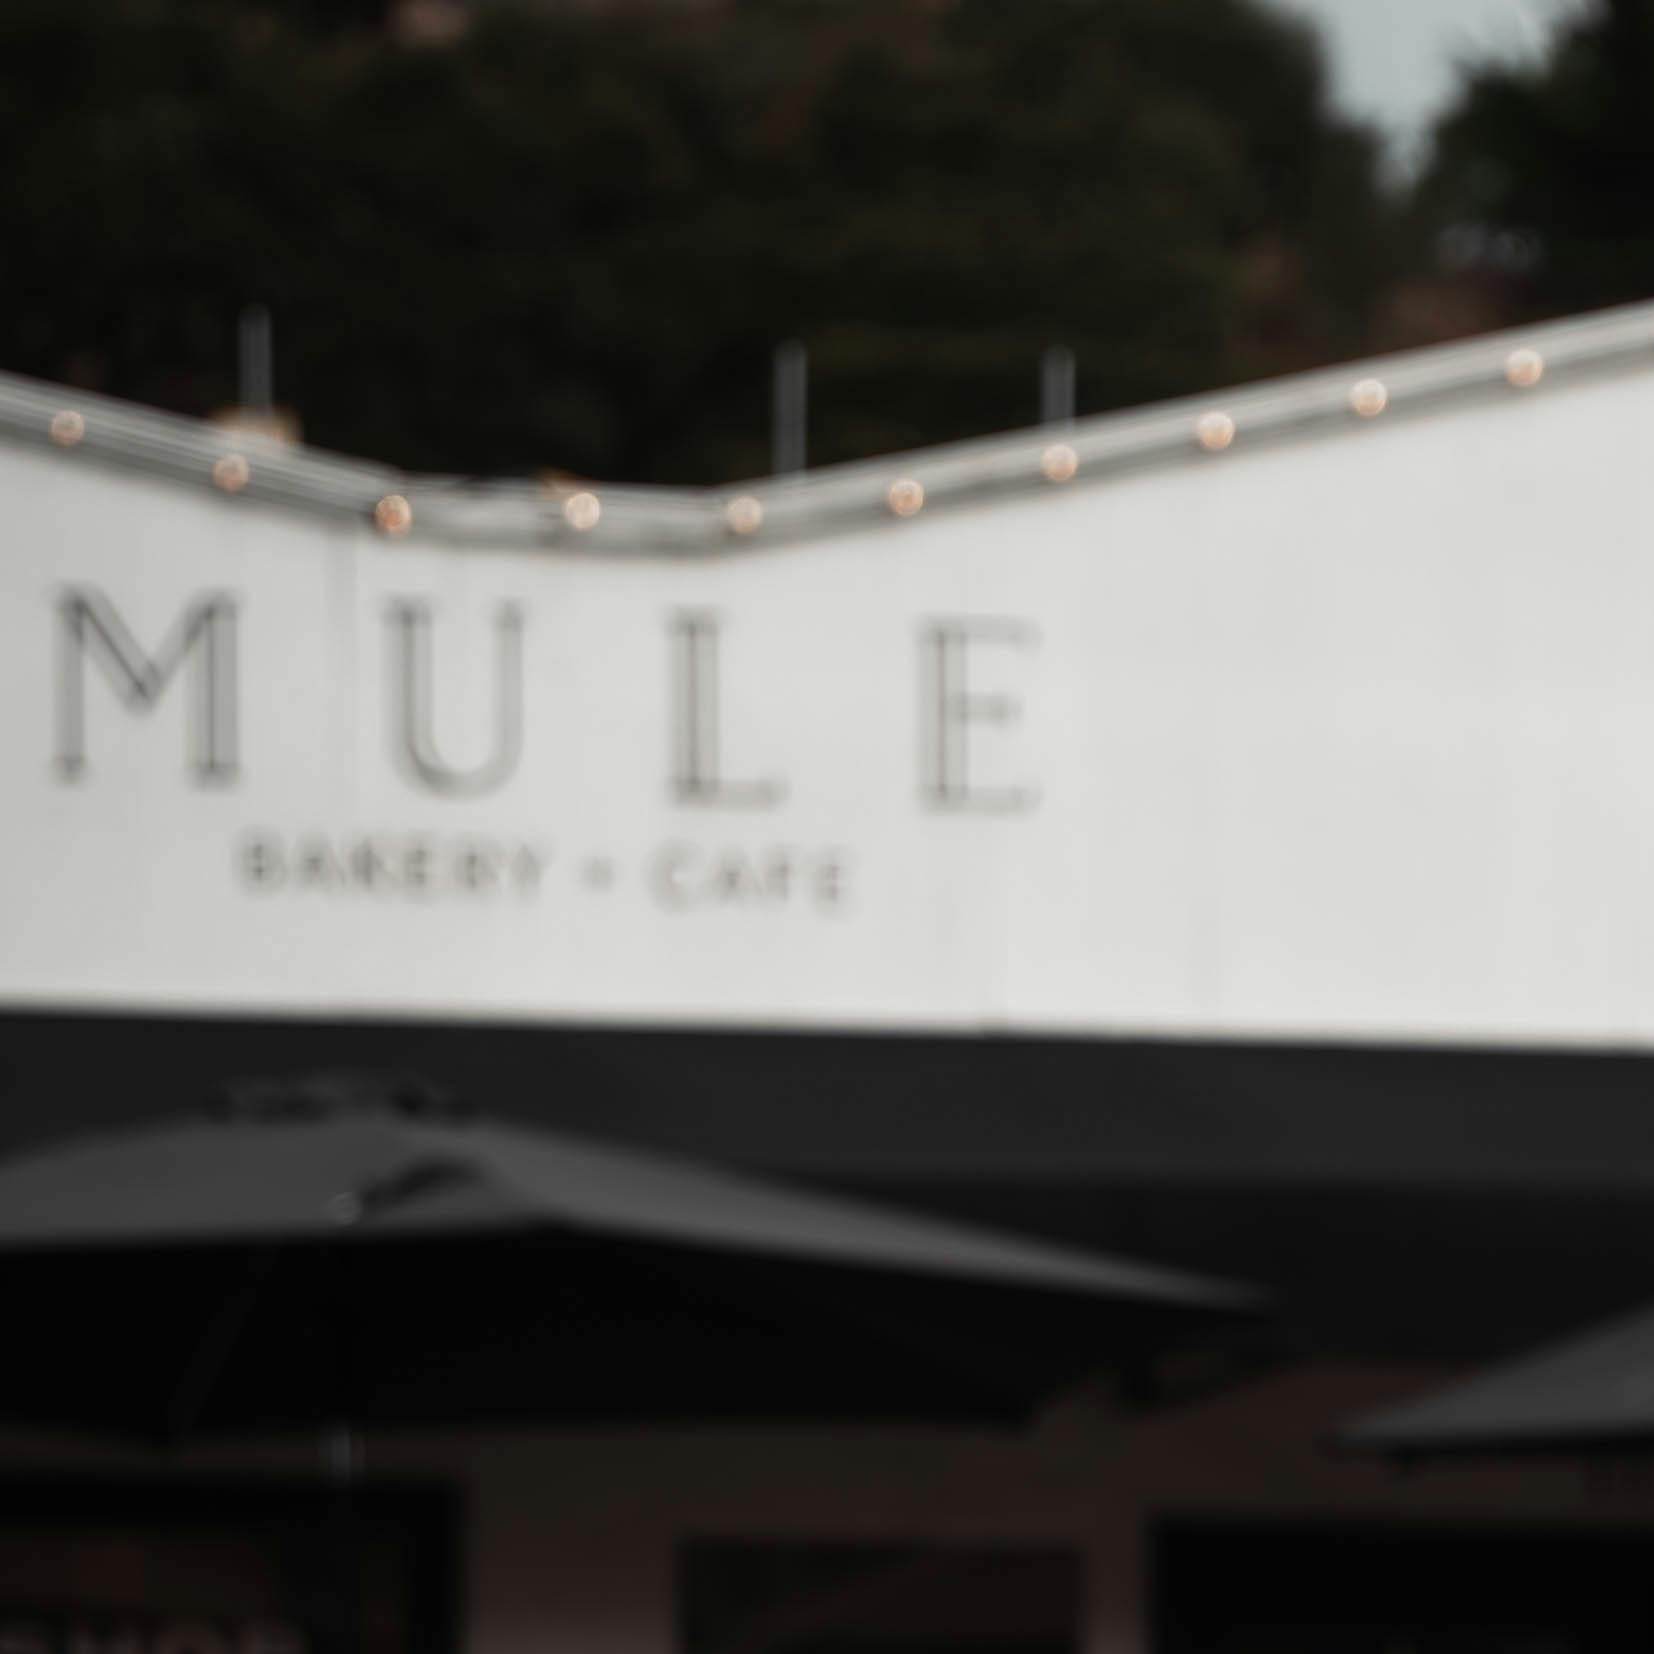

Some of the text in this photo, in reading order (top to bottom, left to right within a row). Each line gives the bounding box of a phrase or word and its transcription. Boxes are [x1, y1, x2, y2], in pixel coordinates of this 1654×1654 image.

[53, 585, 1037, 812] MULE
[236, 829, 547, 899] BAKERY
[650, 843, 855, 914] CAFE
